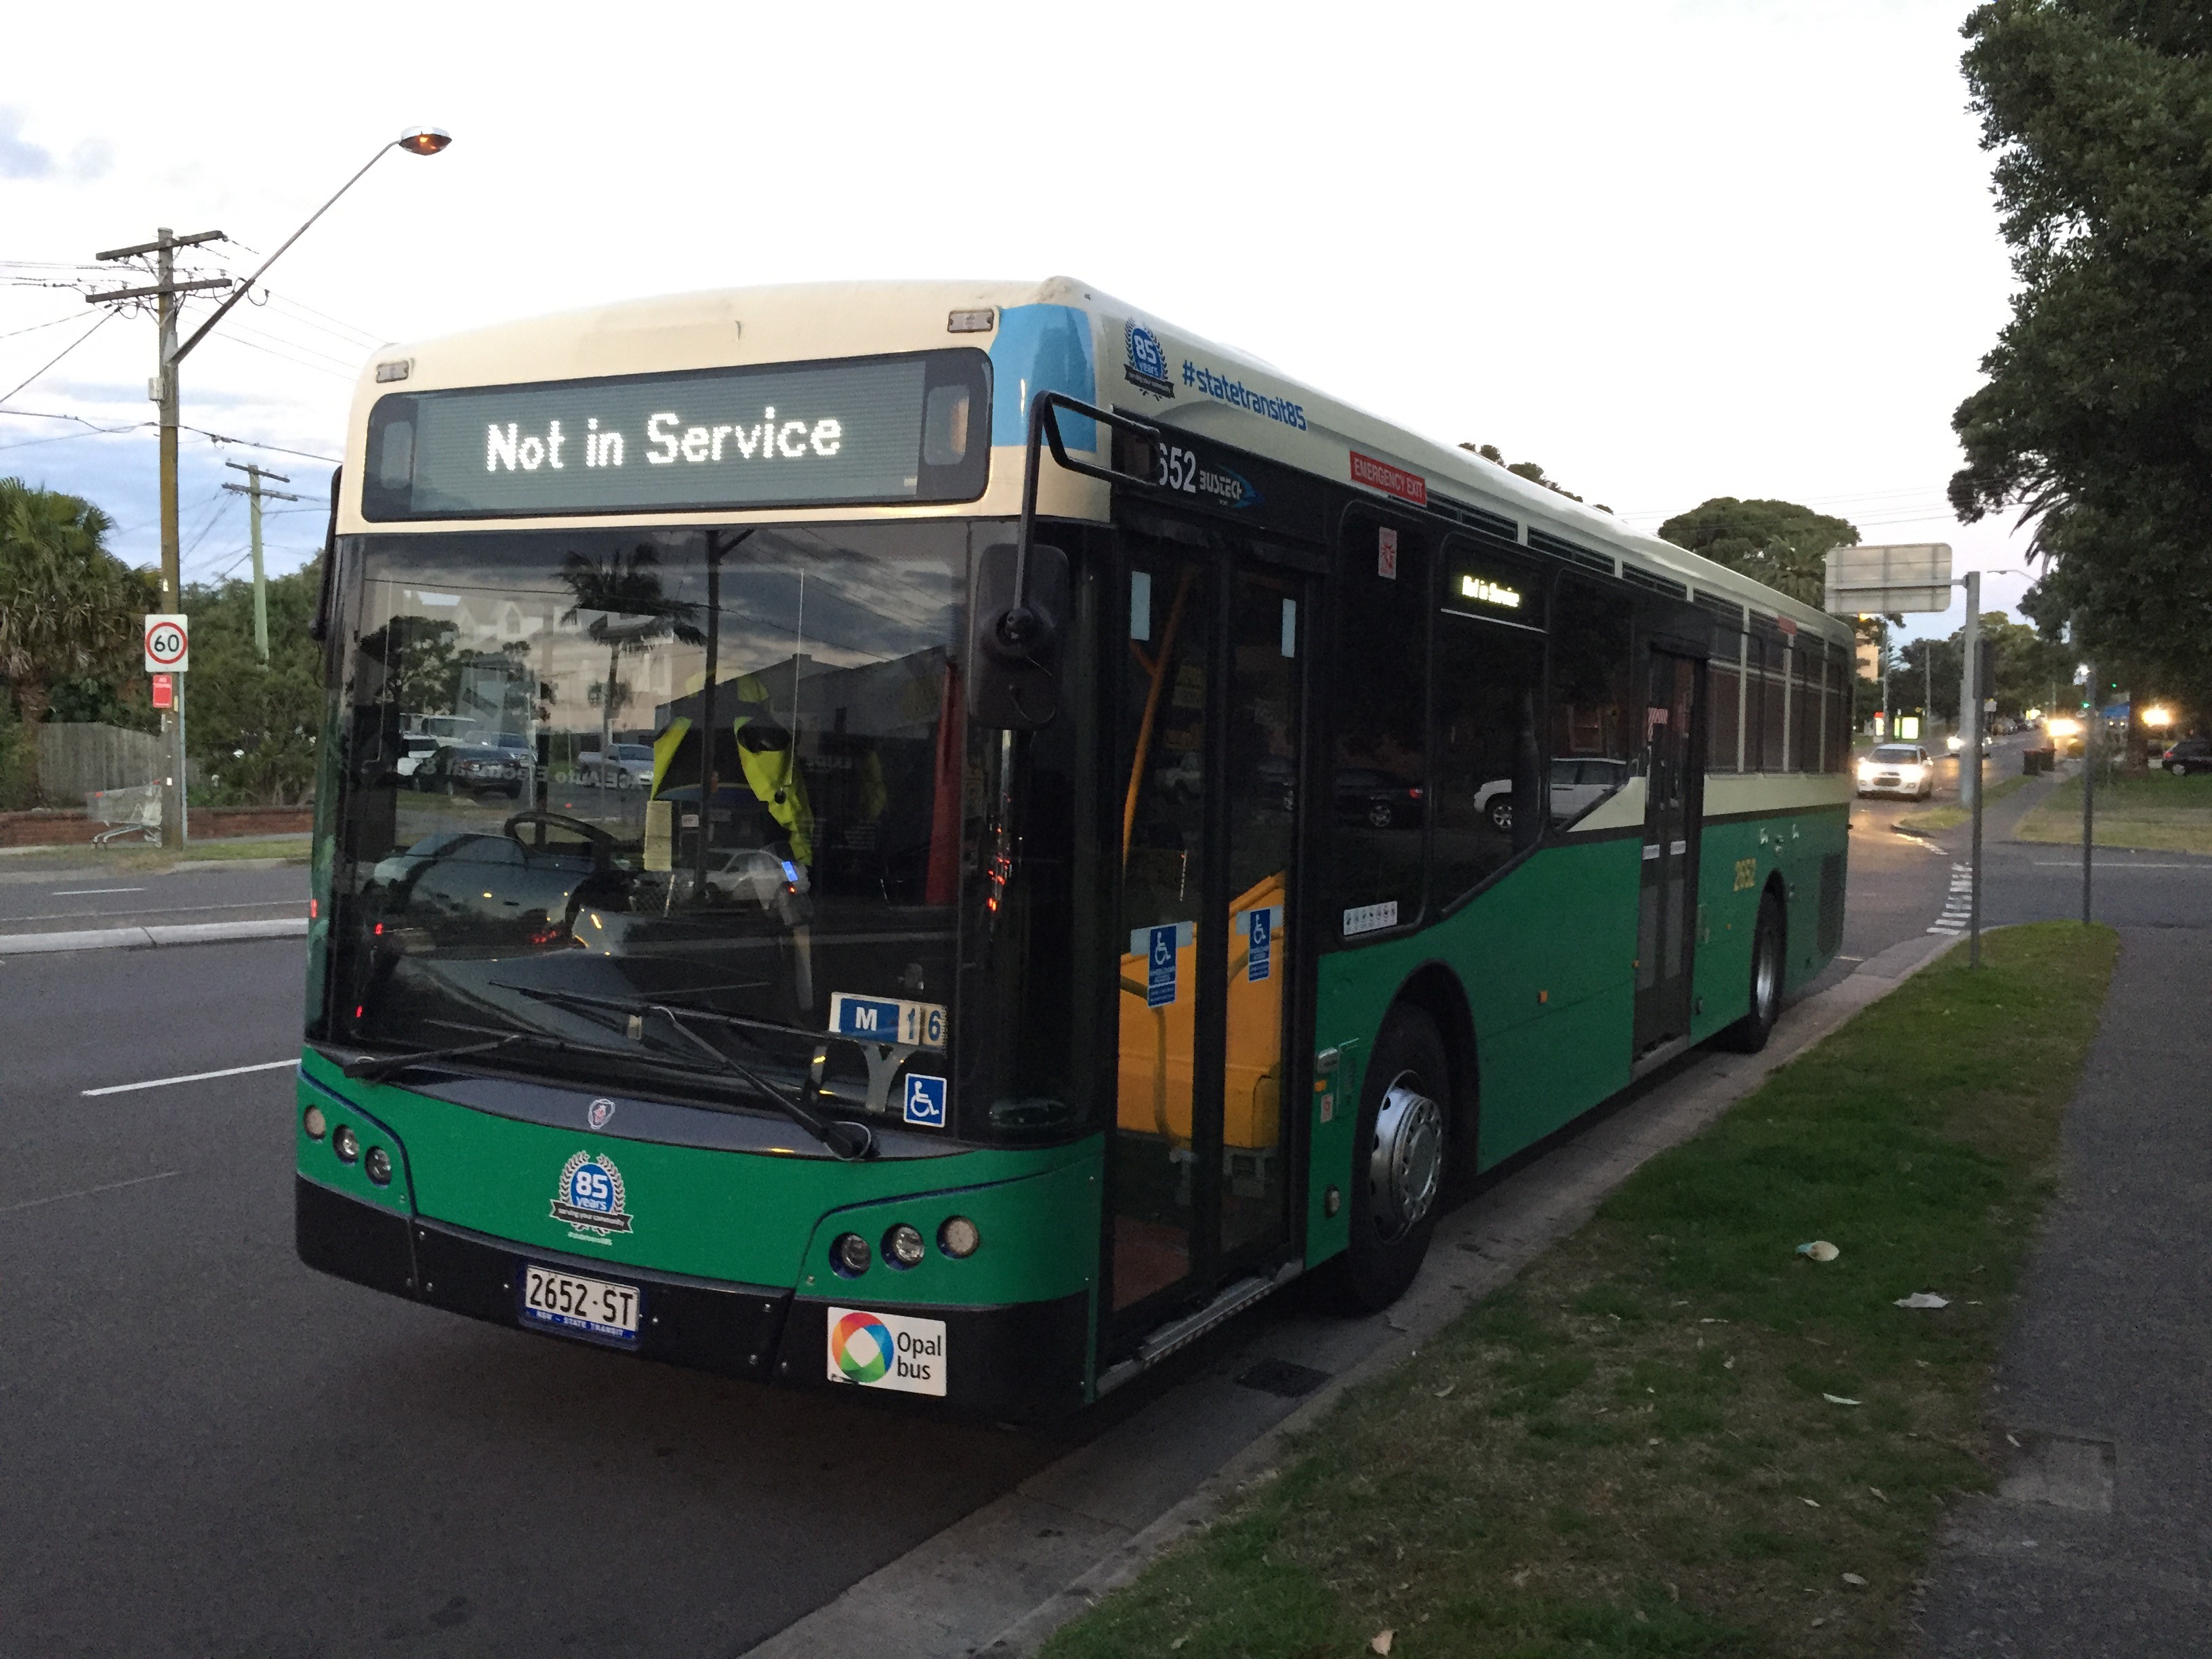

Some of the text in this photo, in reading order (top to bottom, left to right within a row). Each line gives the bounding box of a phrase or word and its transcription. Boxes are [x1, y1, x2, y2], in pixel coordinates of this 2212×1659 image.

[1133, 335, 1157, 365] 85
[1139, 361, 1159, 377] years
[1182, 359, 1307, 431] #statetransit85
[487, 406, 842, 472] Not in Service
[1353, 457, 1423, 499] EMERGENCY EXIT
[154, 634, 180, 652] 60
[855, 1006, 878, 1031] M
[576, 1171, 609, 1199] 85
[576, 1196, 607, 1210] years
[897, 1332, 941, 1359] Opal
[897, 1355, 931, 1380] bus
